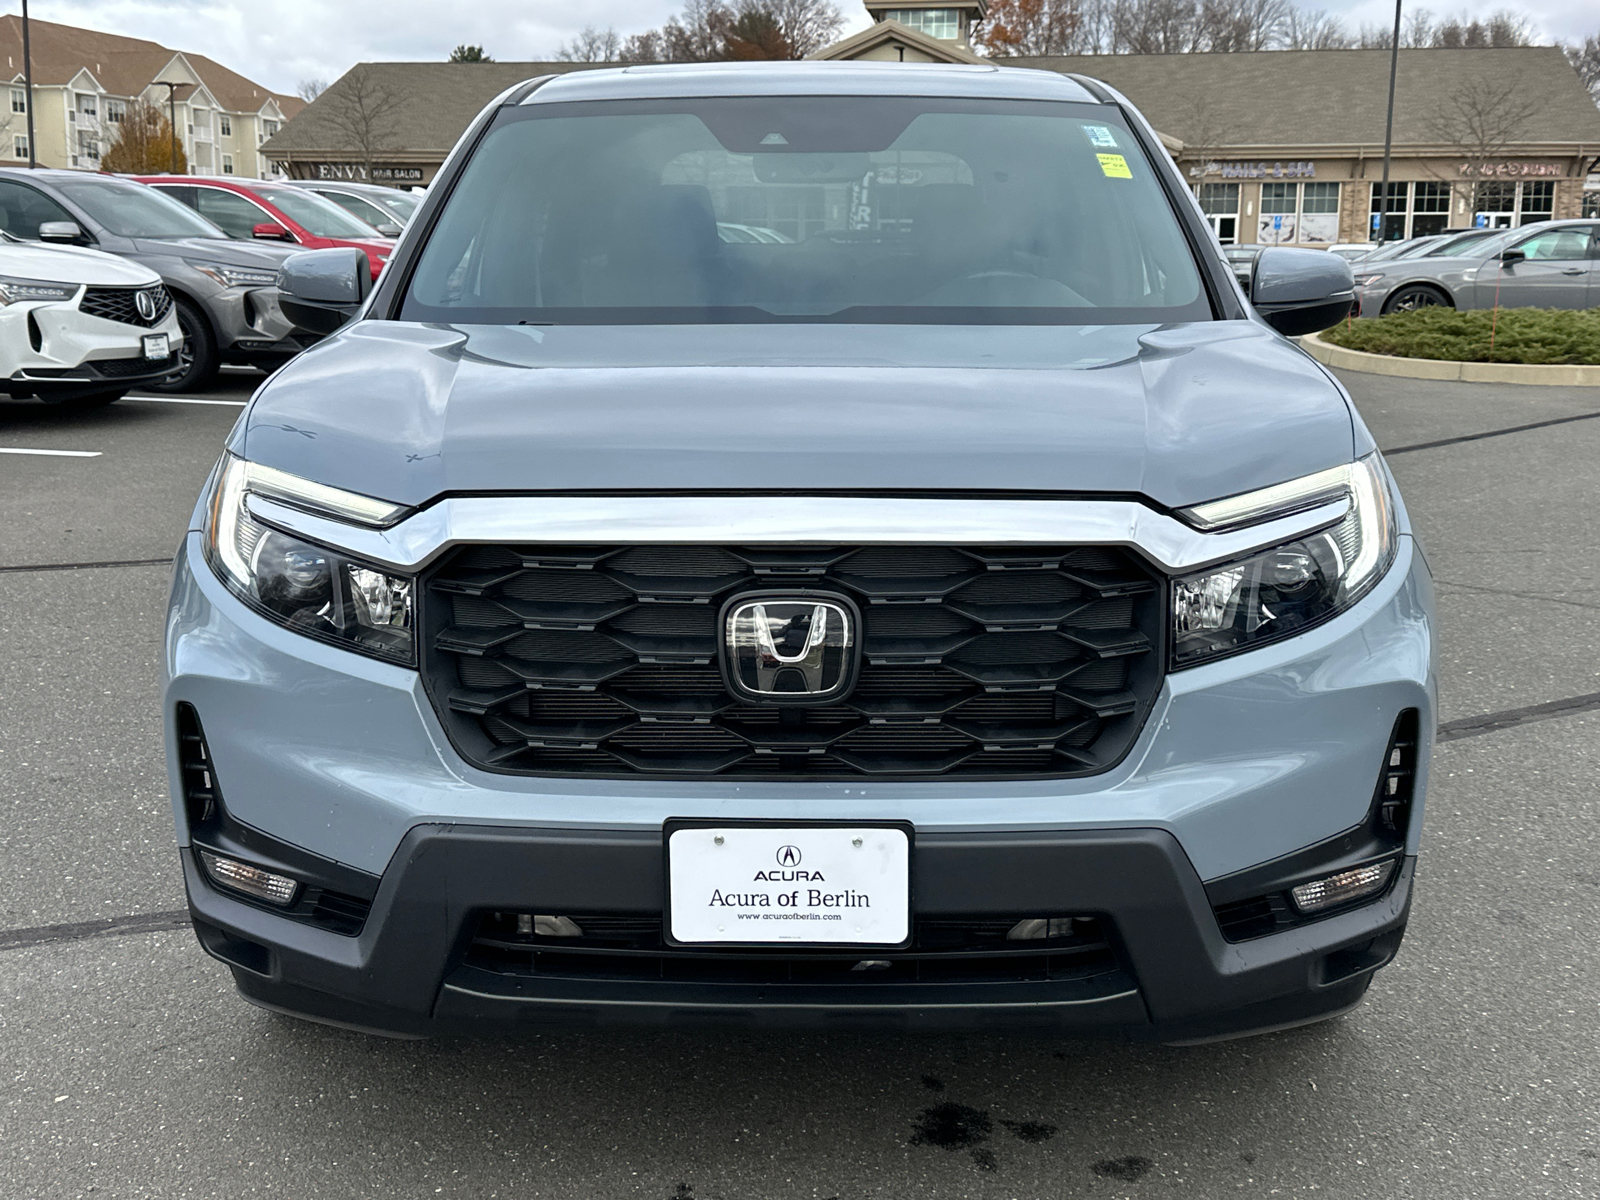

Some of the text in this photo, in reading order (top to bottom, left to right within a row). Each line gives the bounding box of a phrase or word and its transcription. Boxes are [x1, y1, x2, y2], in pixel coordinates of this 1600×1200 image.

[319, 164, 420, 180] ENVY HAIR SALON
[1222, 163, 1266, 178] NAILS
[1273, 162, 1283, 178] &
[1287, 162, 1315, 177] SPA
[753, 871, 825, 882] ACURA
[708, 889, 871, 908] Acura of Berlin
[737, 912, 842, 921] www.acuraofberlin.com
